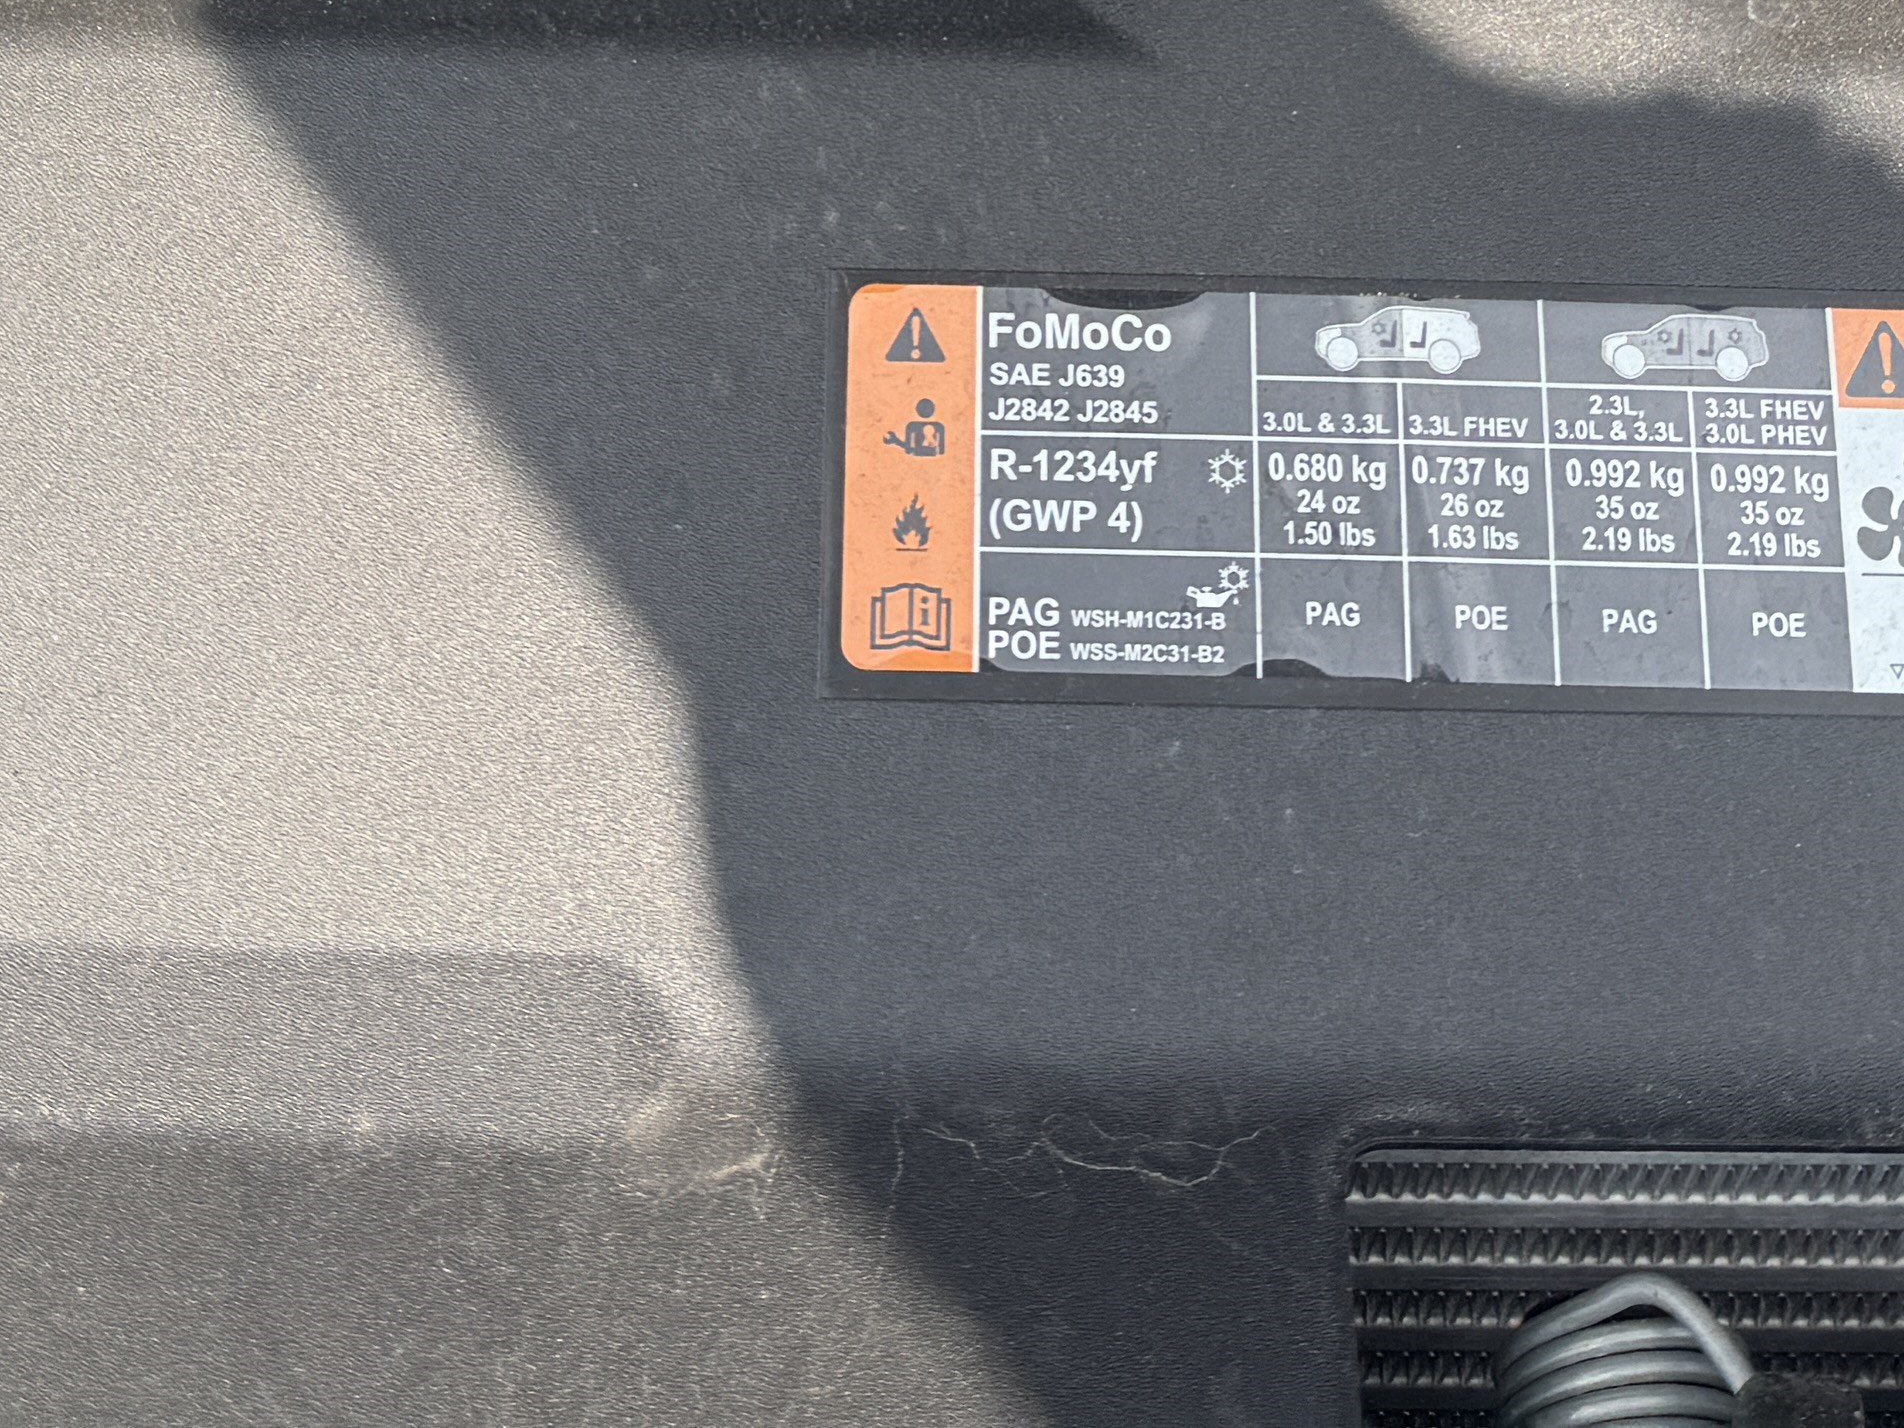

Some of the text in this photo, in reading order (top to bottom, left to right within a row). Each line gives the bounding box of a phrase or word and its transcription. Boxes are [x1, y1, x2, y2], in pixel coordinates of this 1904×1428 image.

[988, 312, 1172, 352] FoMoCo
[988, 362, 1126, 388] SAE J639
[988, 397, 1158, 424] J2842 J2845
[1588, 394, 1645, 418] 2.3L,
[1704, 398, 1825, 421] 3.3L FHEV
[1262, 411, 1391, 435] 3.0L & 3.3L
[1408, 414, 1529, 438] 3.3L FHEV
[1554, 419, 1684, 442] 3.0L & 3.3L
[1705, 422, 1828, 446] 3.0L PHEV
[990, 448, 1158, 492] R-1234yf
[1268, 452, 1387, 491] 0.680 kg
[1411, 455, 1530, 495] 0.737 kg
[1565, 458, 1684, 497] 0.992 kg
[1710, 463, 1830, 502] 0.992 kg
[1296, 489, 1361, 514] 24 oz
[1440, 492, 1505, 518] 26 oz
[1595, 494, 1660, 521] 35 oz
[1740, 500, 1805, 526] 35 oz
[989, 498, 1144, 543] (GWP 4)
[1283, 520, 1376, 547] 1.50 lbs
[1428, 524, 1520, 551] 1.63 lbs
[1582, 526, 1676, 554] 2.19 lbs
[1727, 531, 1822, 558] 2.19 lbs
[988, 596, 1226, 631] PAG WSH-M1C231-B
[1305, 601, 1362, 627] PAG
[1454, 604, 1509, 631] POE
[1602, 608, 1658, 635] PAG
[1752, 611, 1807, 638] POE
[988, 630, 1225, 664] POE WSS-M2C31-B2
